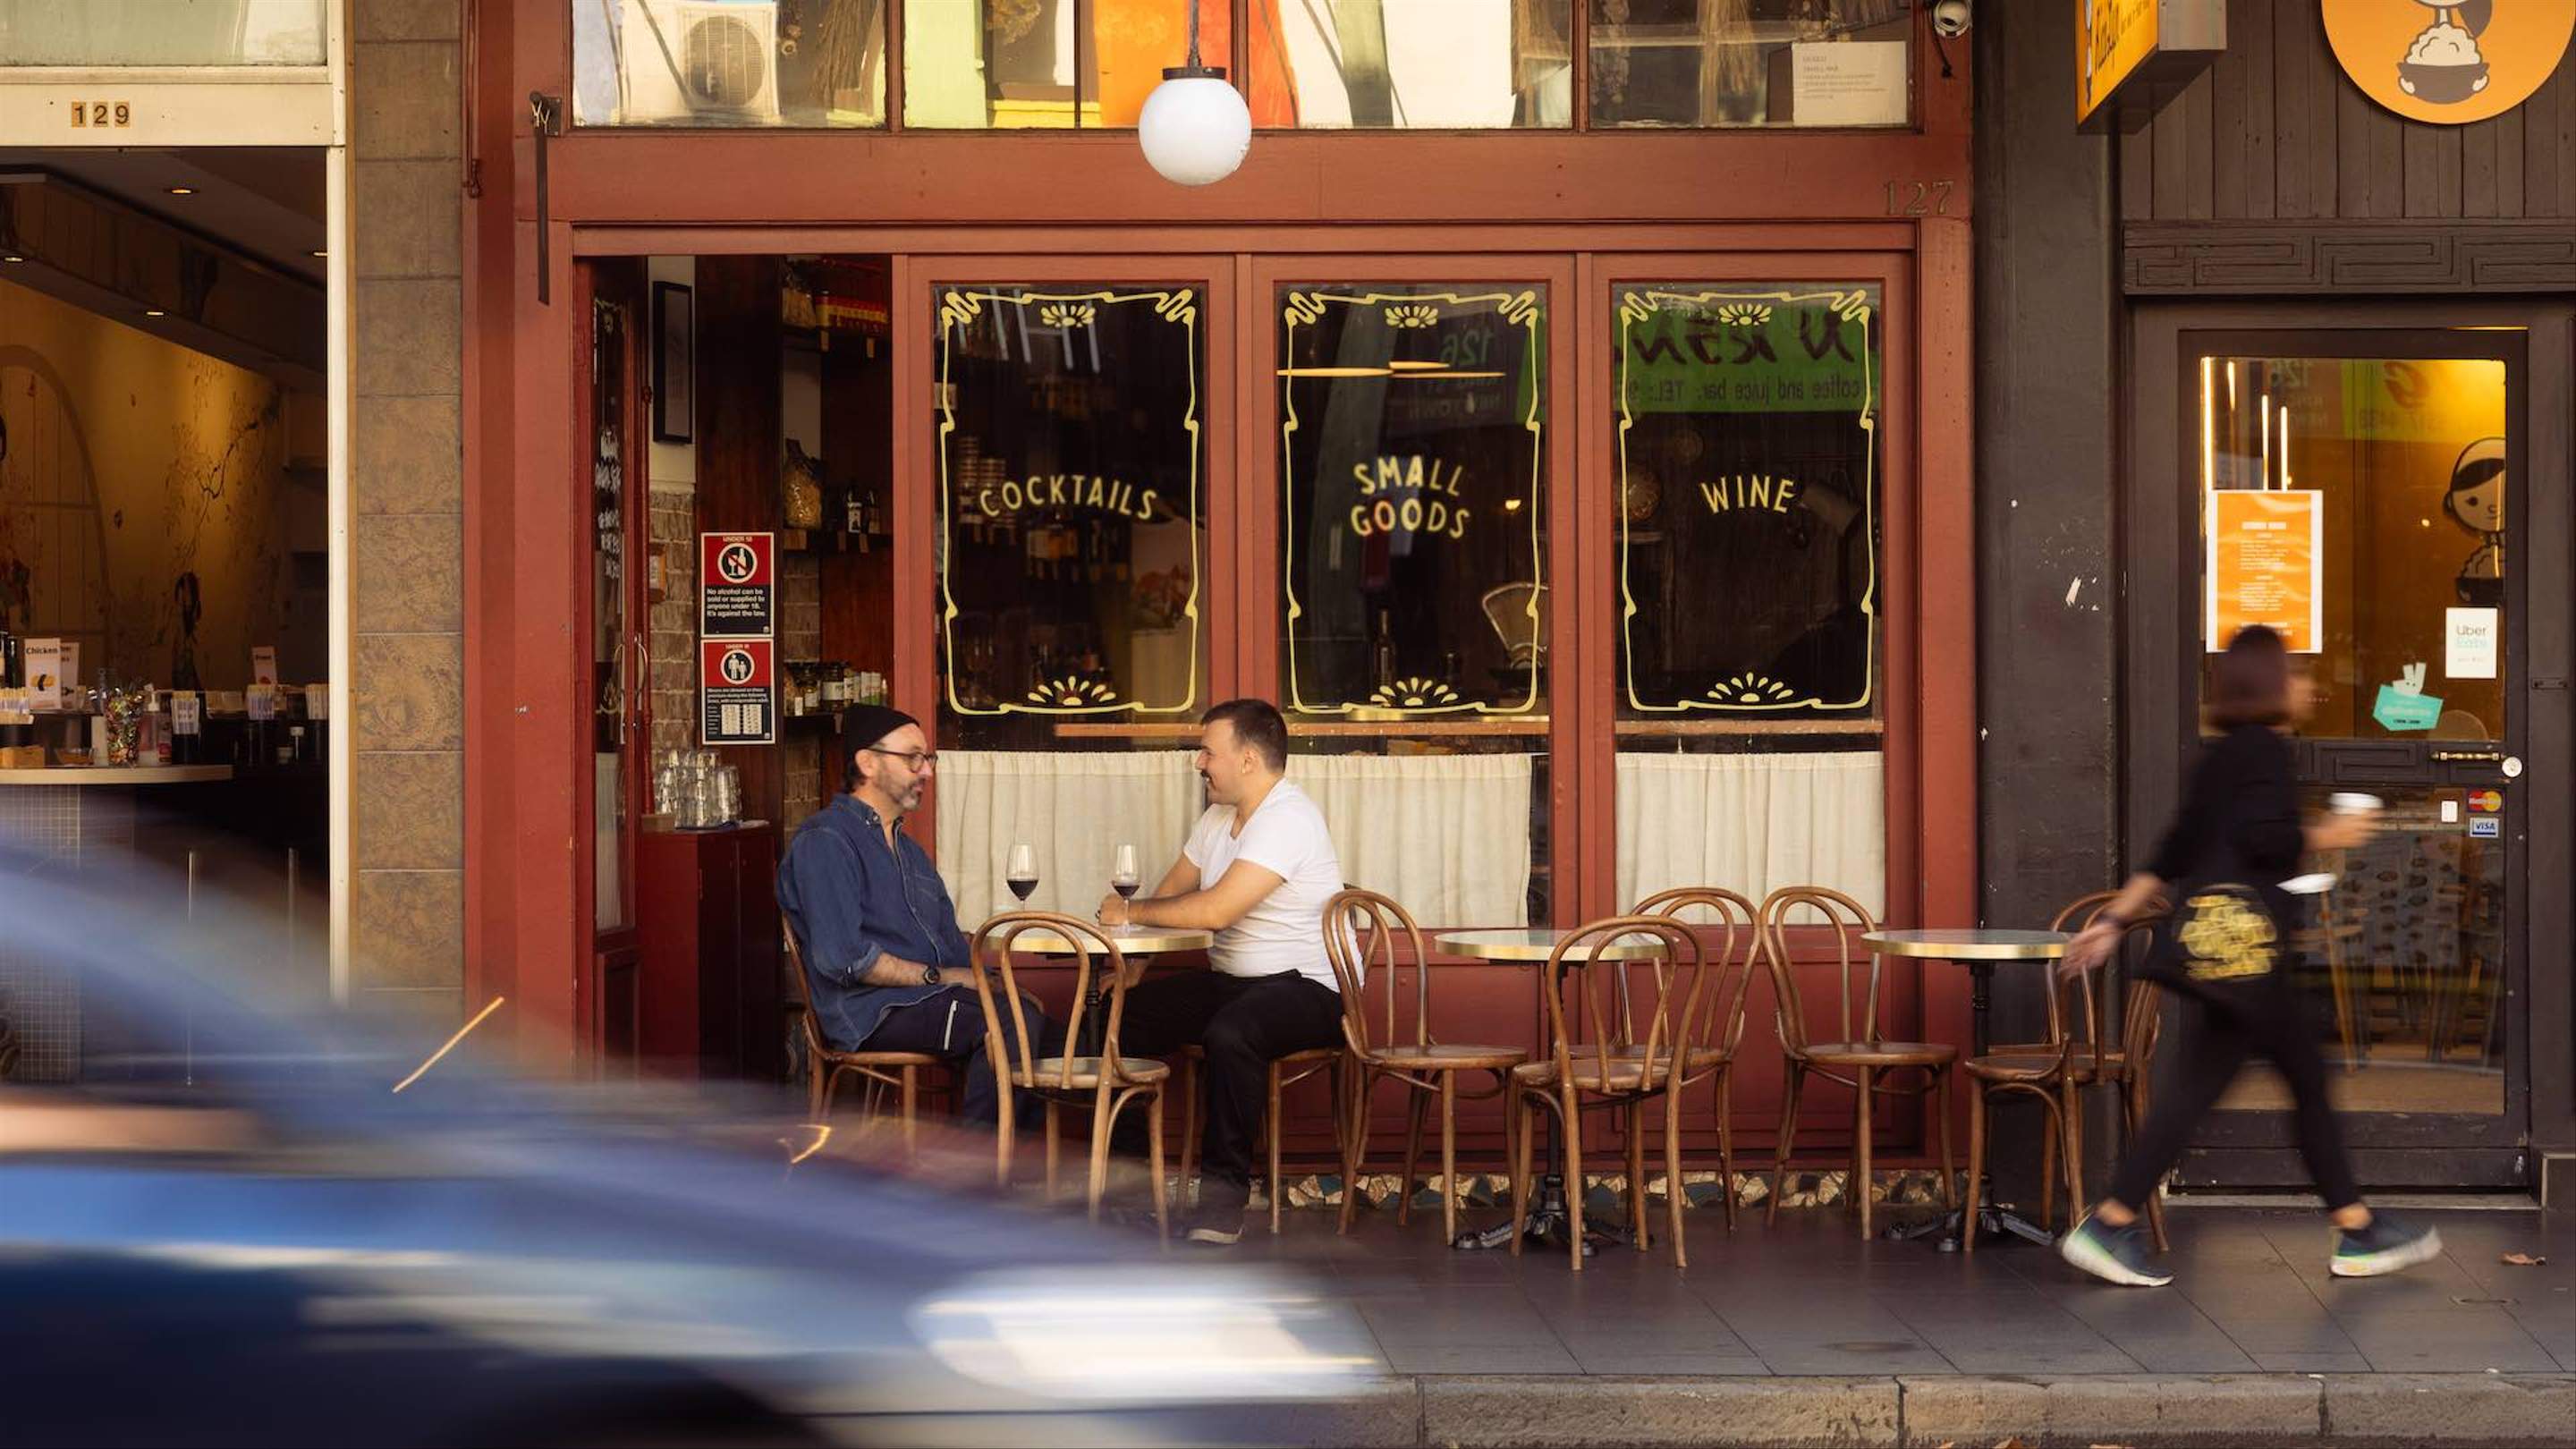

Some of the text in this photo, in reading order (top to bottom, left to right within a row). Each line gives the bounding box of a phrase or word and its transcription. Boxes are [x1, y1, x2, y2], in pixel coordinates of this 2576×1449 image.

[73, 103, 130, 127] 129
[1884, 181, 1956, 216] 127
[1352, 455, 1465, 497] SMALL
[979, 474, 1157, 521] COCKTAILS
[1700, 474, 1798, 515] WINE
[1351, 497, 1471, 540] GOODS
[729, 596, 757, 604] supplied
[717, 610, 741, 618] against
[2456, 624, 2488, 639] Uber
[25, 646, 59, 656] Chicken
[2475, 821, 2496, 830] VISA
